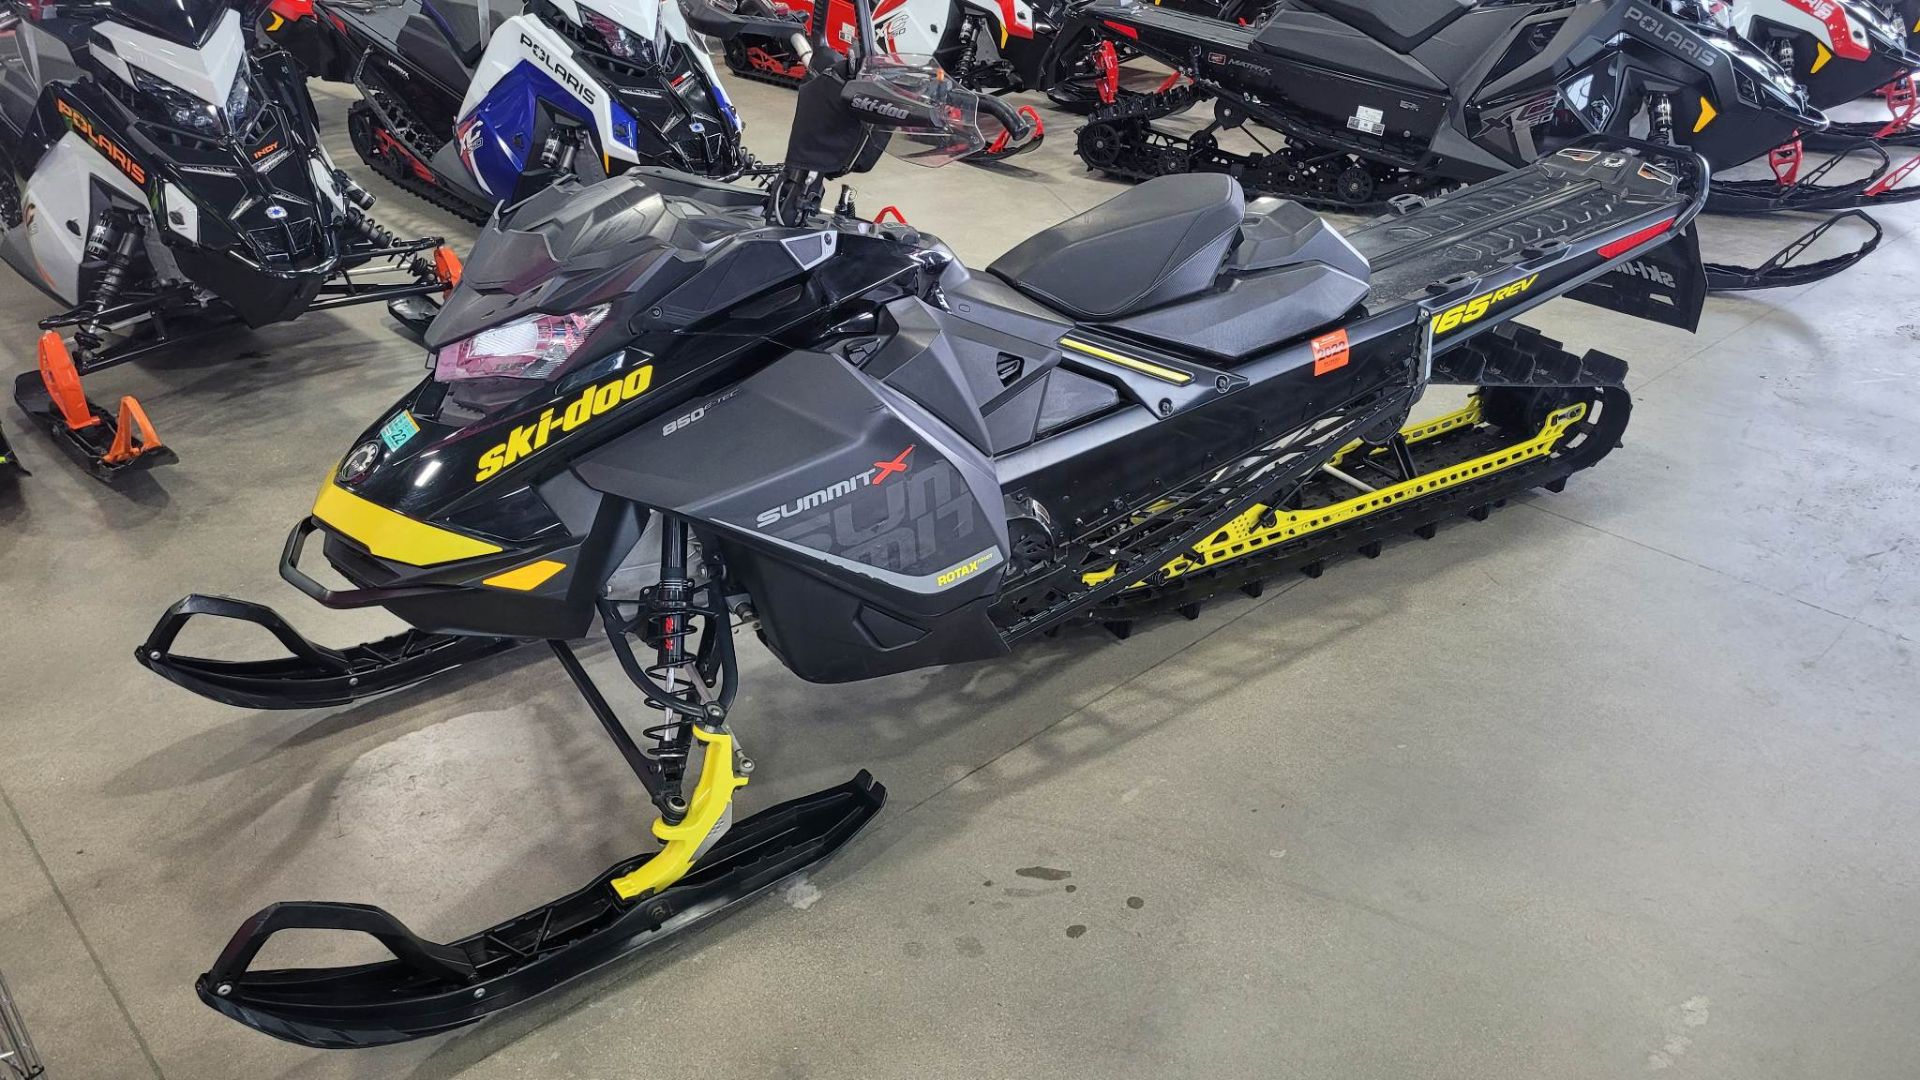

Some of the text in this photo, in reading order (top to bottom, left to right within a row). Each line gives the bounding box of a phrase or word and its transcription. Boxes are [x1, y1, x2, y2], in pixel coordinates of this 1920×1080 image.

[1624, 6, 1718, 66] POLARIS
[519, 32, 597, 106] POLARIS
[851, 96, 911, 120] ski-doo
[57, 98, 146, 185] POLARIS
[253, 141, 279, 159] INDY
[1490, 273, 1540, 304] REV
[1316, 341, 1347, 361] 2022
[391, 429, 407, 445] 22
[475, 365, 653, 482] ski-doo
[662, 407, 705, 437] 850
[756, 444, 914, 528] SUMMIT X
[937, 560, 978, 587] ROTAX
